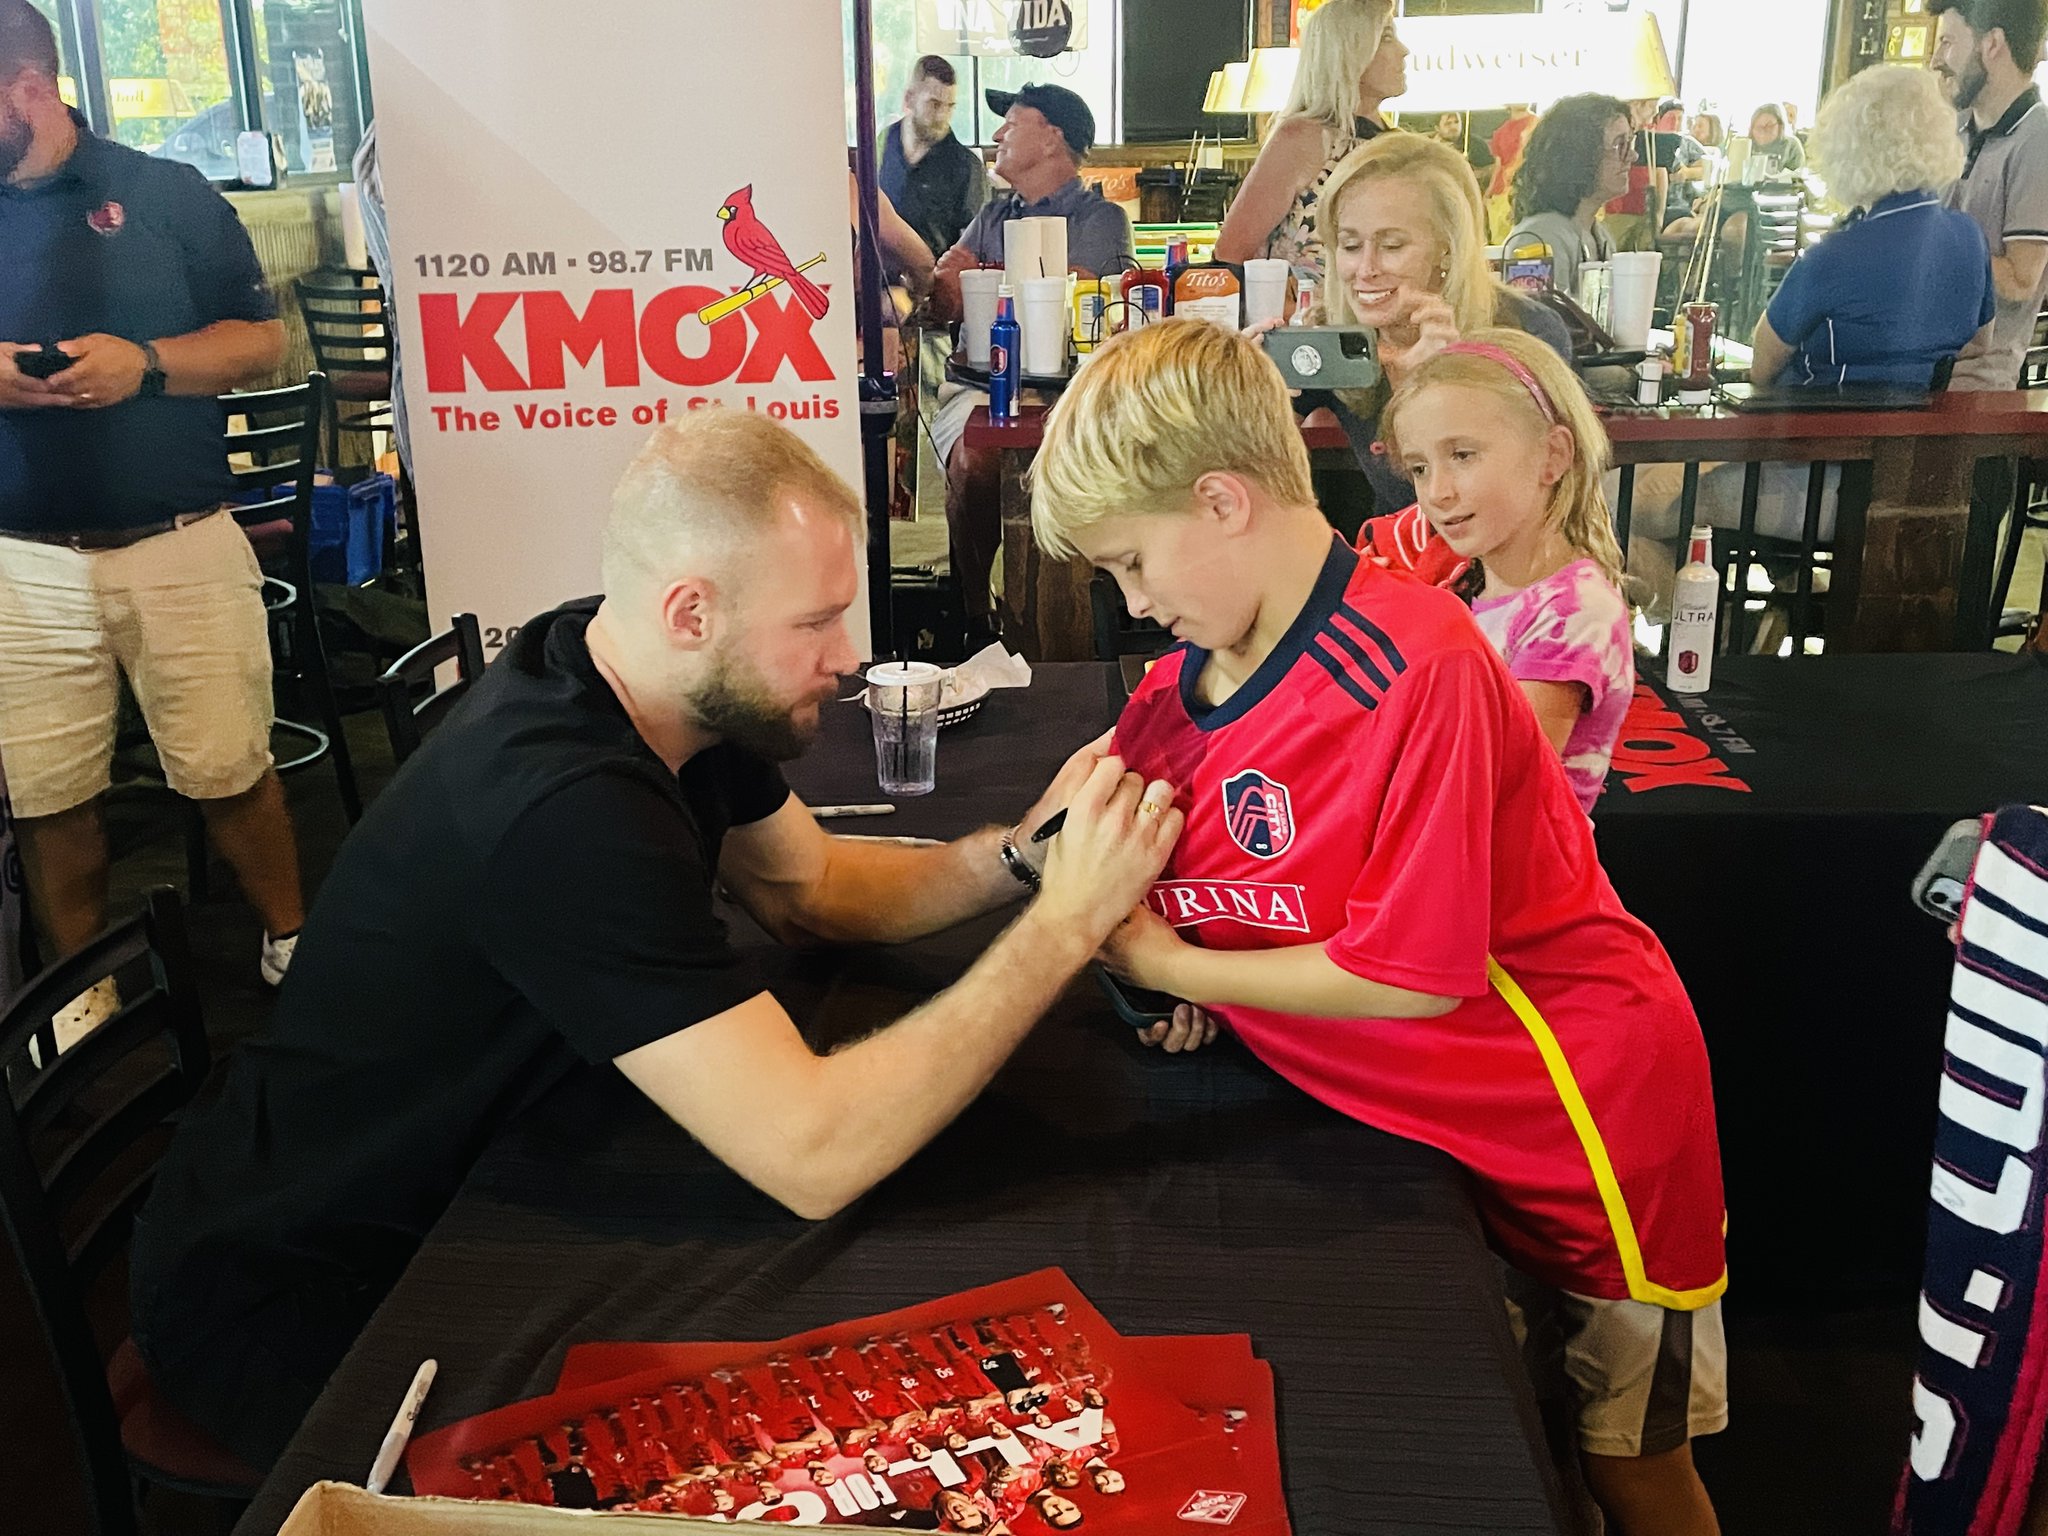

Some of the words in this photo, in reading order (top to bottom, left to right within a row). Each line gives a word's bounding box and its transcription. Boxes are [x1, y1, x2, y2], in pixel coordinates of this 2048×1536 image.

[1413, 45, 1588, 71] udweiser
[1081, 174, 1127, 192] Tto's
[415, 254, 490, 277] 1120
[502, 252, 557, 276] AM
[587, 250, 653, 274] 98.7
[664, 248, 714, 272] FM
[1186, 272, 1228, 287] Tito's
[418, 284, 837, 393] KMOX
[431, 406, 500, 432] The
[514, 402, 617, 430] Voice
[632, 398, 668, 425] of
[1265, 793, 1283, 840] CITY
[1154, 887, 1299, 923] RINA
[889, 1408, 1103, 1487] ALL
[825, 1468, 898, 1517] FOR
